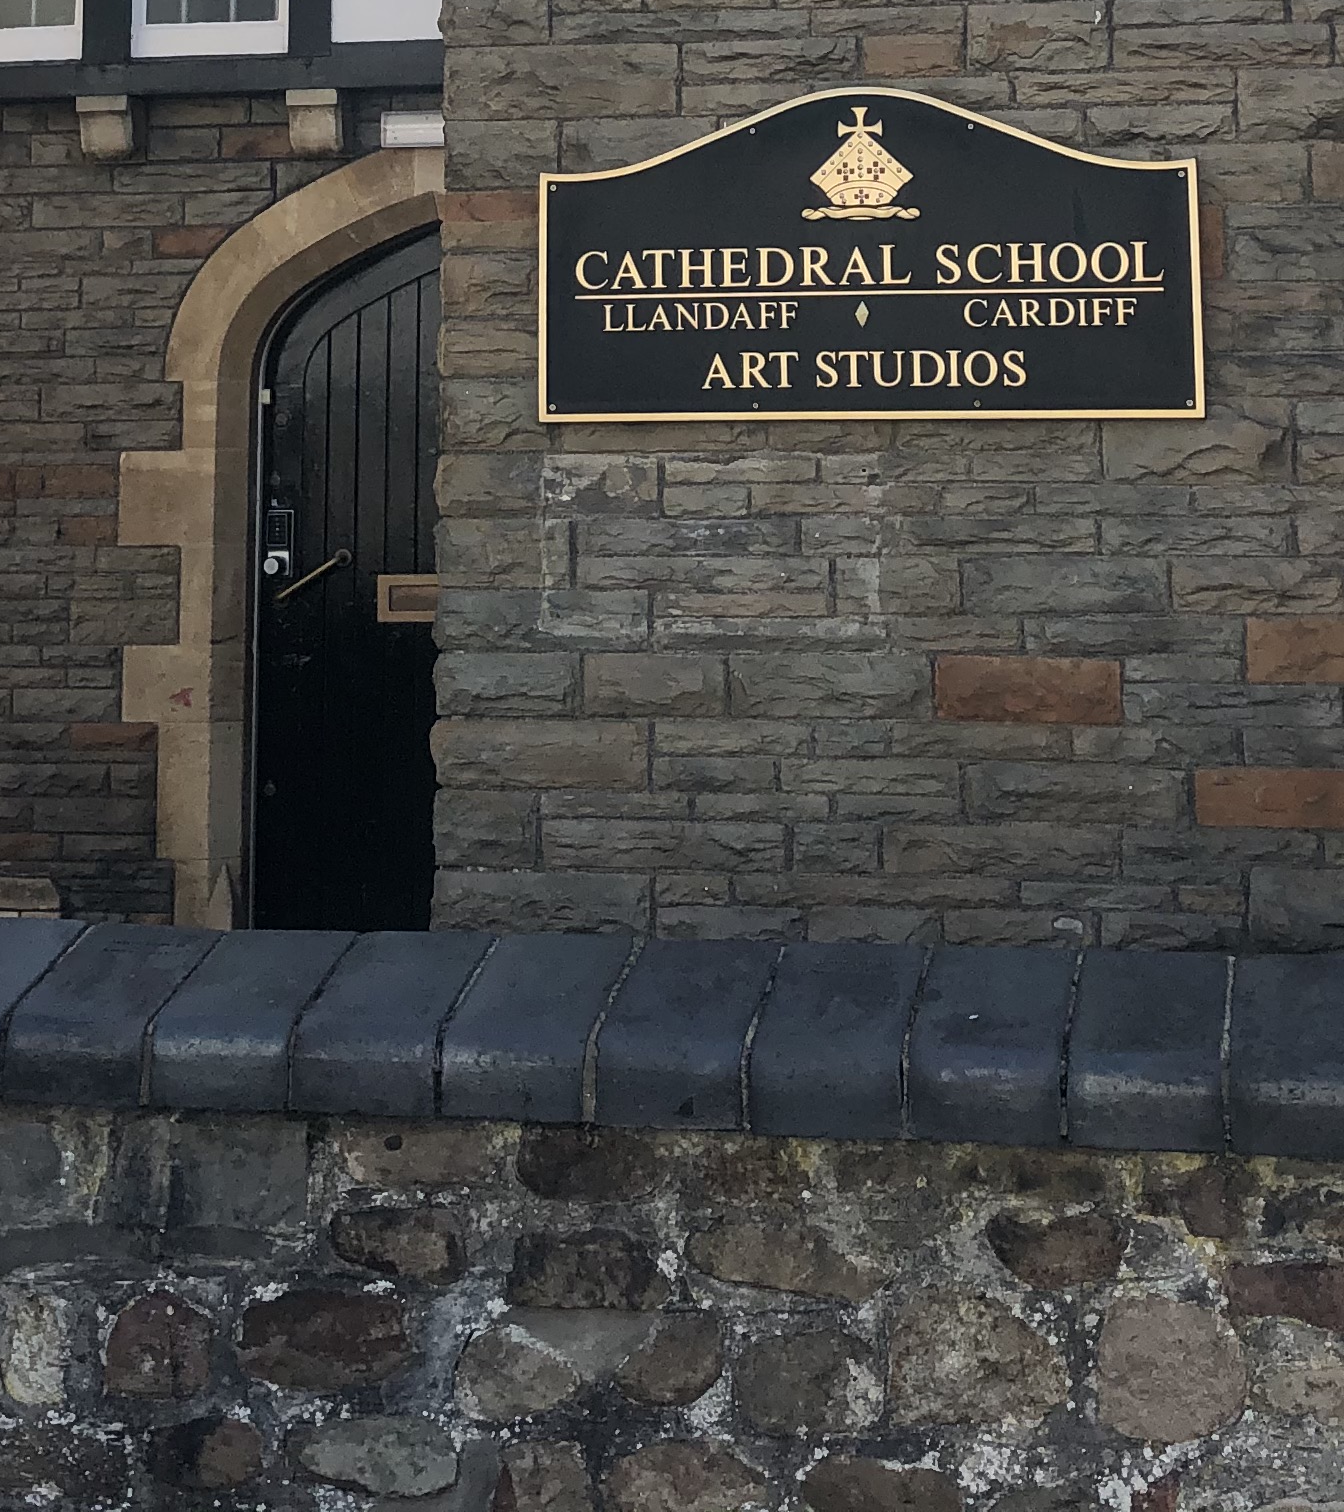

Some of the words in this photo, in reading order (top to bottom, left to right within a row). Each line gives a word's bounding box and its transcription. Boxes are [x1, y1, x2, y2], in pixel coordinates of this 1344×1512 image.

[575, 244, 912, 290] CATHEDRAL
[935, 241, 1165, 285] SCHOOL
[602, 301, 799, 332] LLANDAFF
[963, 297, 1138, 328] CARDIFF
[701, 351, 799, 390] ART
[815, 349, 1027, 388] STUDIOS
